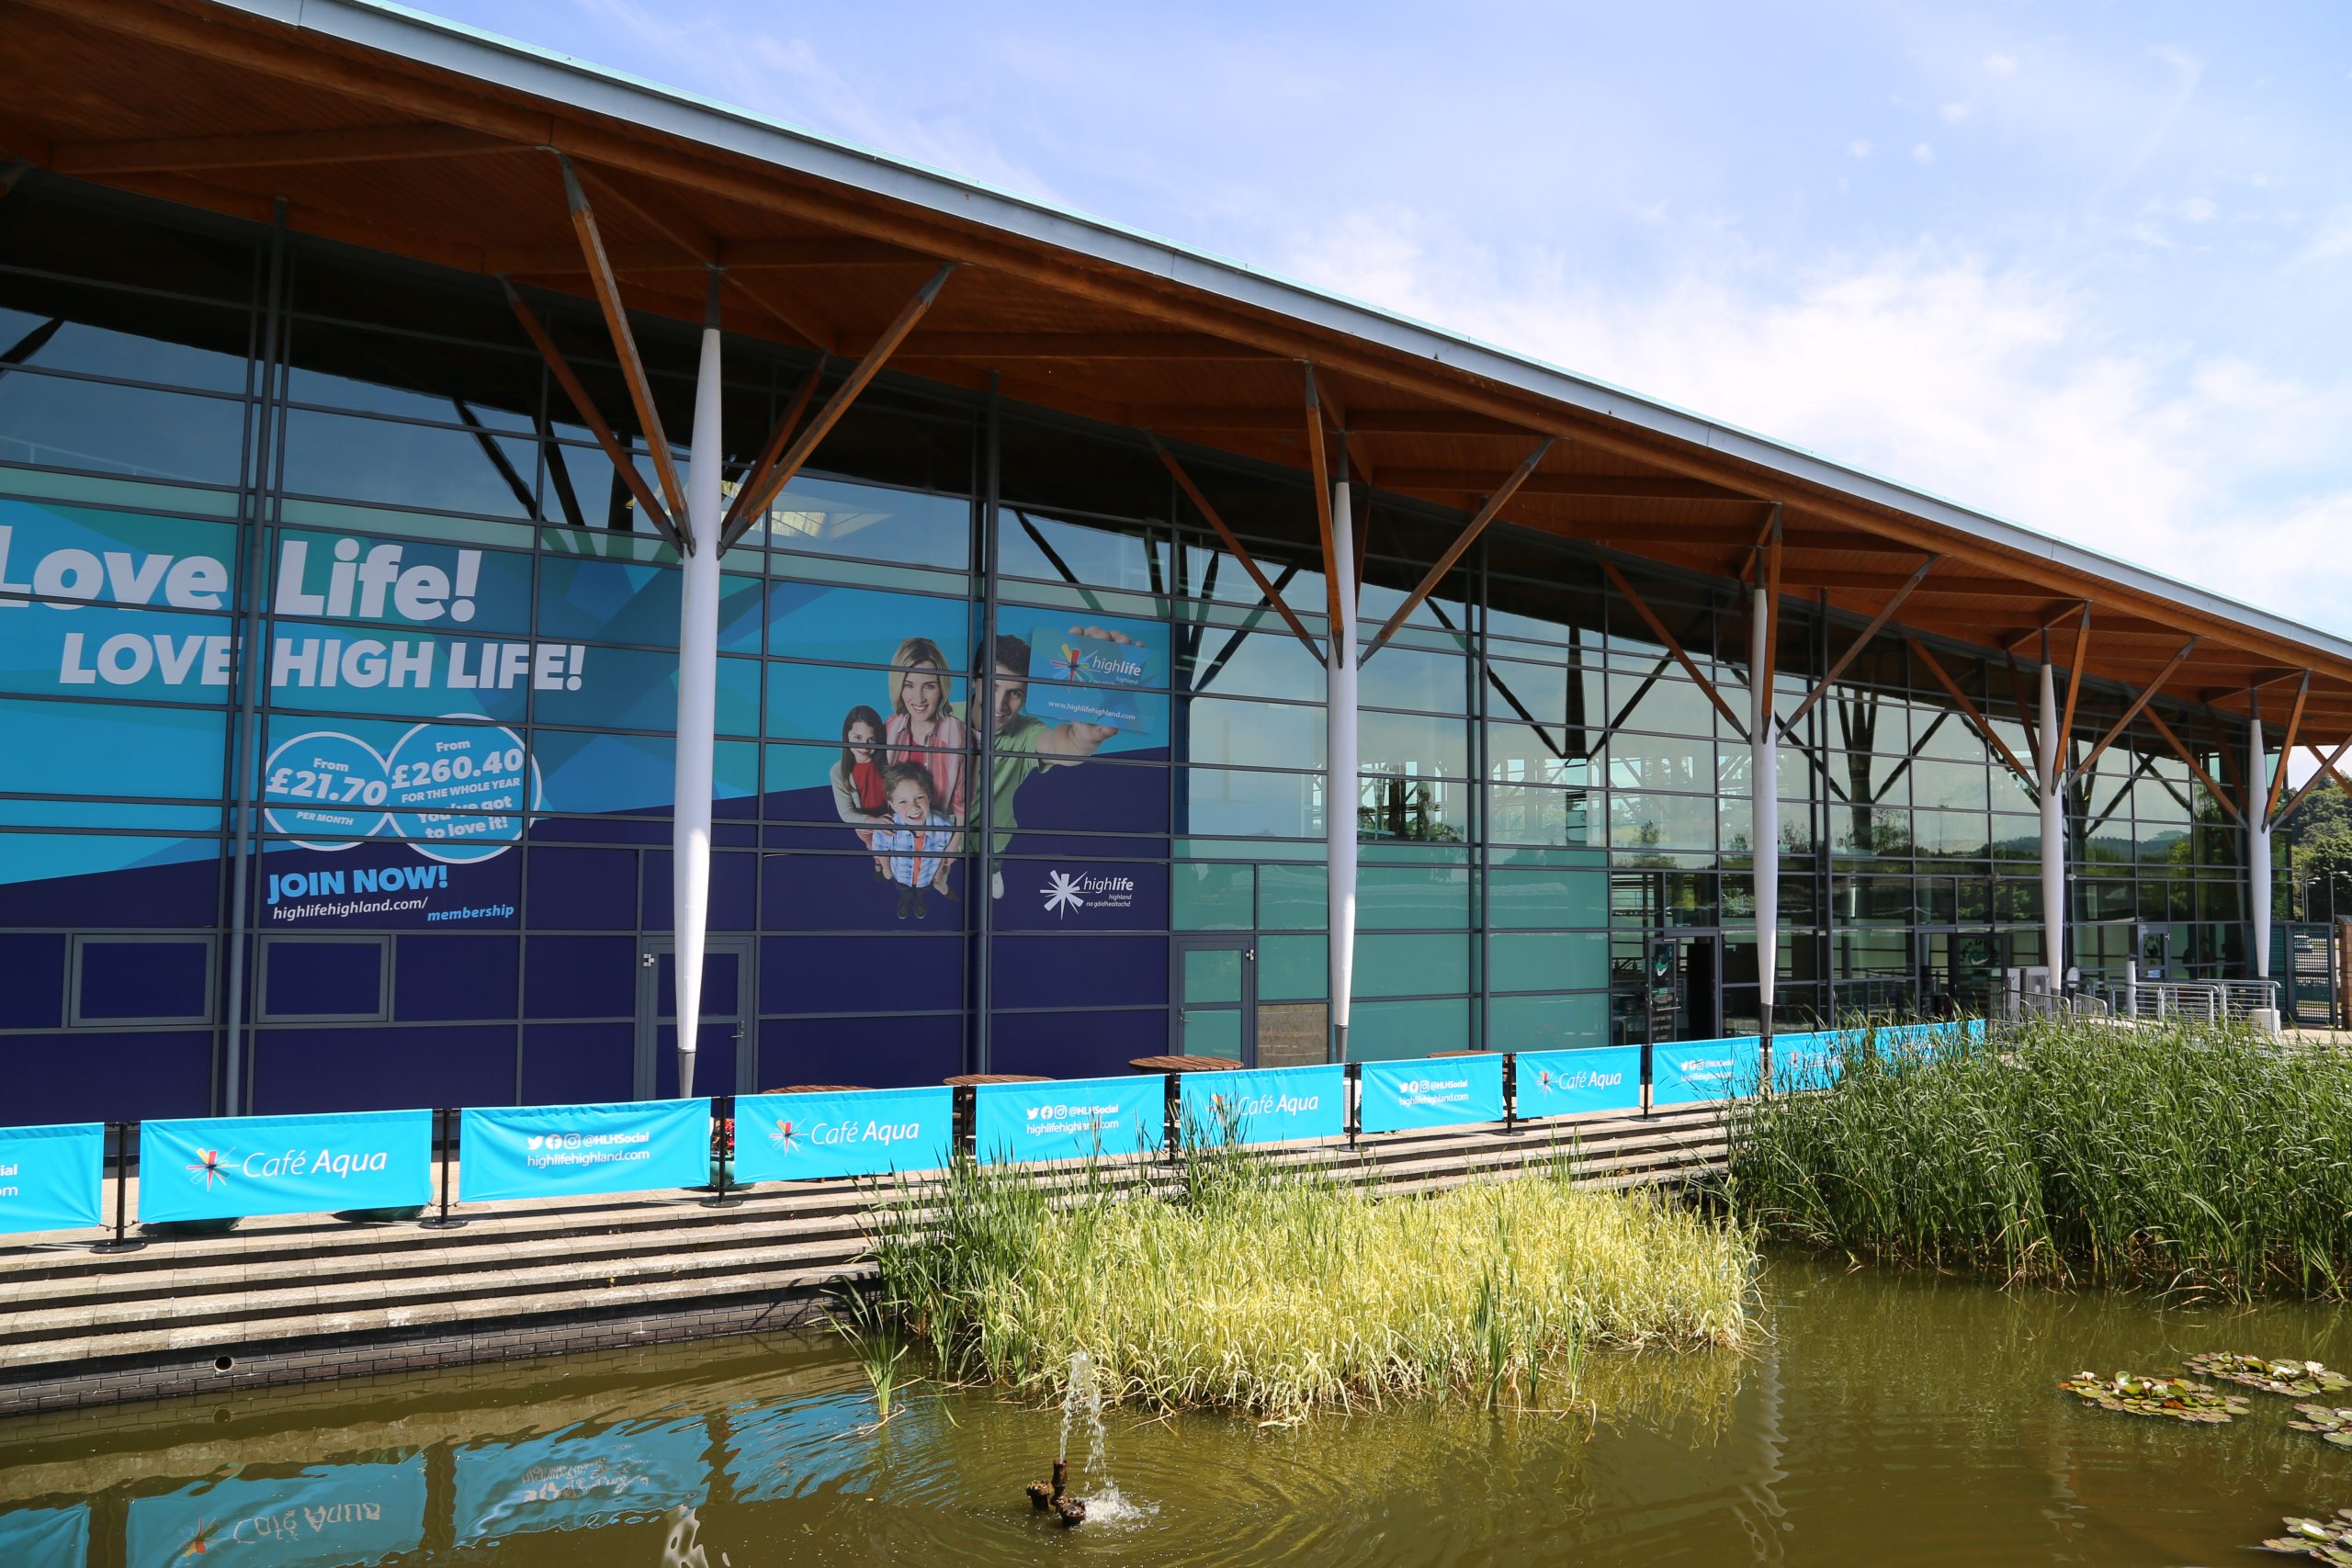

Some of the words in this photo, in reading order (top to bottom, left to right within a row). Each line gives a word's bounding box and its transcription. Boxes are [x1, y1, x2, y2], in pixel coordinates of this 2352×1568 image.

[0, 525, 228, 611] Love
[275, 538, 482, 622] Life!
[59, 632, 243, 685] LOVE
[271, 637, 435, 689] HIGH
[447, 642, 586, 692] LIFE!
[1092, 656, 1142, 676] highlife
[1048, 700, 1136, 721] www.highlifehighland.com
[435, 740, 471, 752] From
[313, 757, 349, 773] From
[391, 748, 525, 789] £260.40
[266, 767, 388, 806] £21.70
[401, 794, 424, 804] FOR
[426, 790, 448, 799] THE
[449, 784, 490, 795] WHOLE
[492, 777, 521, 788] YEAR
[297, 812, 315, 820] PER
[316, 815, 354, 825] MONTH
[425, 828, 446, 839] to
[447, 821, 486, 837] love
[489, 816, 508, 830] it!
[267, 871, 345, 904] JOIN
[353, 864, 448, 898] NOW!
[1084, 877, 1134, 894] highlife
[273, 897, 429, 921] highlifehighland.com/
[427, 904, 514, 921] membership
[1559, 1071, 1587, 1090] Café
[1588, 1071, 1622, 1090] Aqua
[1238, 1095, 1272, 1116] Café
[1276, 1095, 1319, 1117] Aqua
[582, 1132, 650, 1147] @HLHSocial
[810, 1121, 859, 1145] Café
[861, 1120, 920, 1146] Aqua
[243, 1149, 307, 1179] Café
[310, 1149, 388, 1179] Aqua
[526, 1150, 650, 1168] highlifehighland.com
